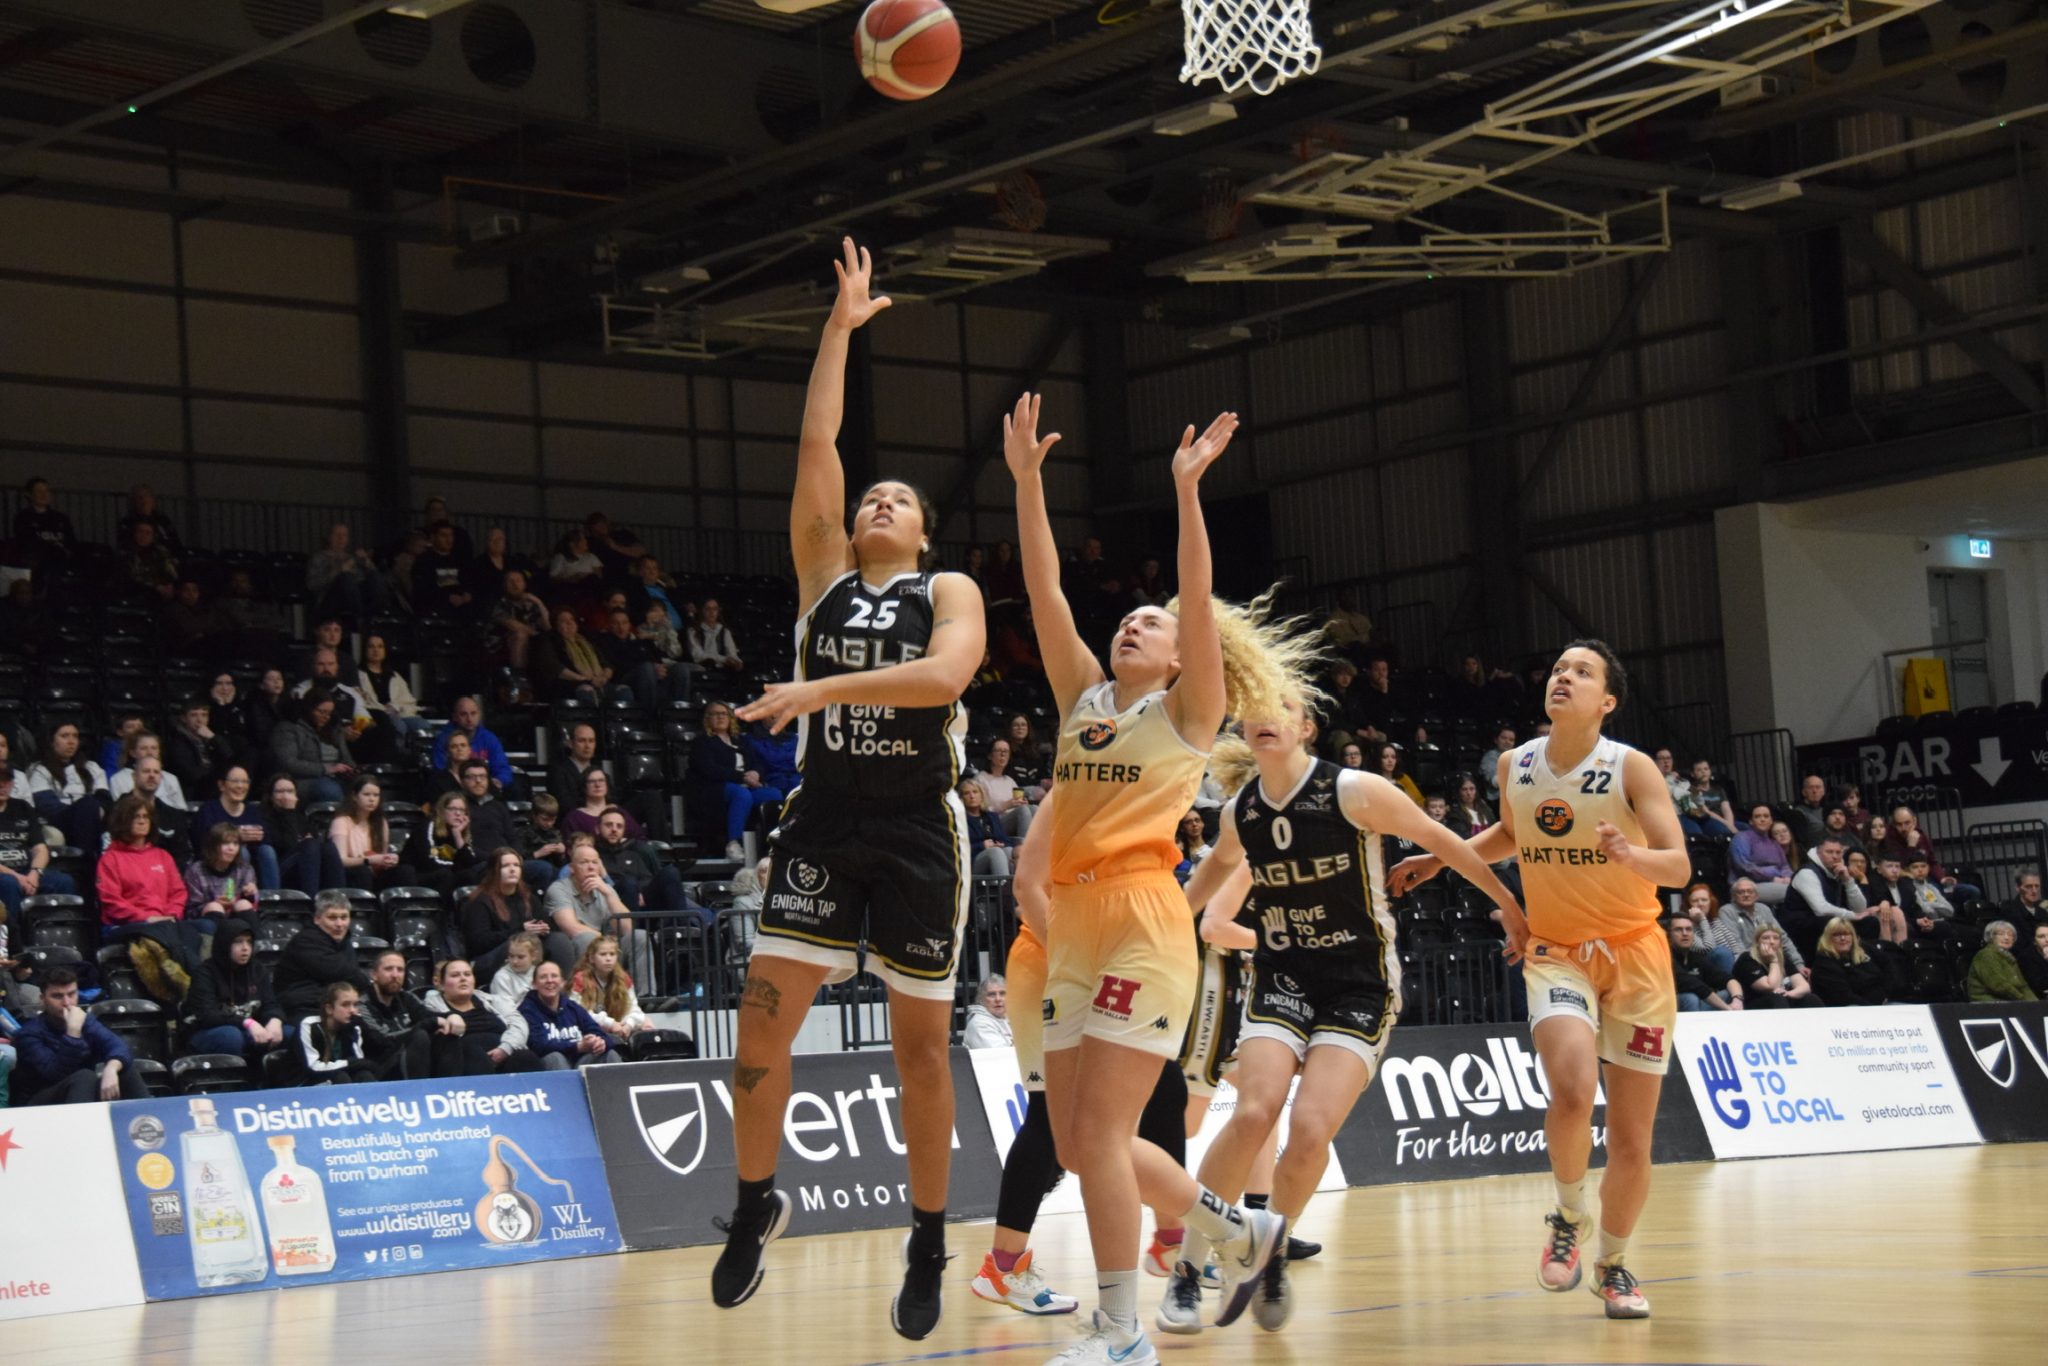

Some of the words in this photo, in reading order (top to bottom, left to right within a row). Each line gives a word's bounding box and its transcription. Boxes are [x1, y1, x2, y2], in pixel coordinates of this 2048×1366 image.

[843, 597, 900, 631] 25
[850, 704, 896, 720] GIVE
[849, 720, 878, 737] TO
[851, 739, 919, 757] LOCAL
[1859, 736, 1952, 785] BAR
[1056, 762, 1142, 783] HATTERS
[1580, 770, 1612, 794] 22
[1272, 816, 1293, 850] 0
[1521, 846, 1608, 865] HATTERS
[1254, 853, 1351, 887] AGLES
[771, 893, 815, 913] ENIGMA
[817, 899, 837, 919] TAP
[1289, 905, 1327, 923] GIVE
[1293, 923, 1315, 936] TO
[1297, 929, 1358, 949] LOCAL
[1263, 993, 1300, 1013] ENIGMA
[1195, 990, 1216, 1059] NEWCASTLE
[1831, 1028, 1860, 1040] We're
[1861, 1028, 1895, 1041] aiming
[1895, 1028, 1905, 1037] to
[1906, 1027, 1922, 1039] put
[1742, 1041, 1797, 1067] GIVE
[1827, 1046, 1845, 1058] £10
[1846, 1045, 1878, 1057] million
[1879, 1047, 1886, 1056] a
[1888, 1046, 1908, 1058] year
[1908, 1043, 1928, 1054] into
[1858, 1060, 1909, 1073] community
[1911, 1060, 1936, 1073] sport
[1381, 1036, 1608, 1121] molt
[1750, 1071, 1786, 1096] TO
[232, 1095, 421, 1133] Distinctively
[425, 1088, 552, 1120] Different
[1763, 1098, 1844, 1125] LOCAL
[1862, 1103, 1954, 1123] givetolocal.com
[321, 1132, 401, 1150] Beautifully
[404, 1125, 492, 1144] handcrafted
[1396, 1126, 1441, 1166] For
[1446, 1120, 1496, 1158] the
[1501, 1129, 1547, 1153] rea
[325, 1151, 367, 1166] small
[370, 1147, 412, 1163] batch
[415, 1146, 438, 1162] gin
[329, 1169, 365, 1183] from
[367, 1164, 428, 1181] Durham
[152, 1201, 181, 1215] GIN
[337, 1206, 356, 1217] See
[357, 1206, 374, 1216] our
[375, 1203, 410, 1216] unique
[411, 1199, 451, 1214] products
[452, 1198, 464, 1207] at
[552, 1203, 592, 1225] WL
[551, 1224, 606, 1241] Distillery
